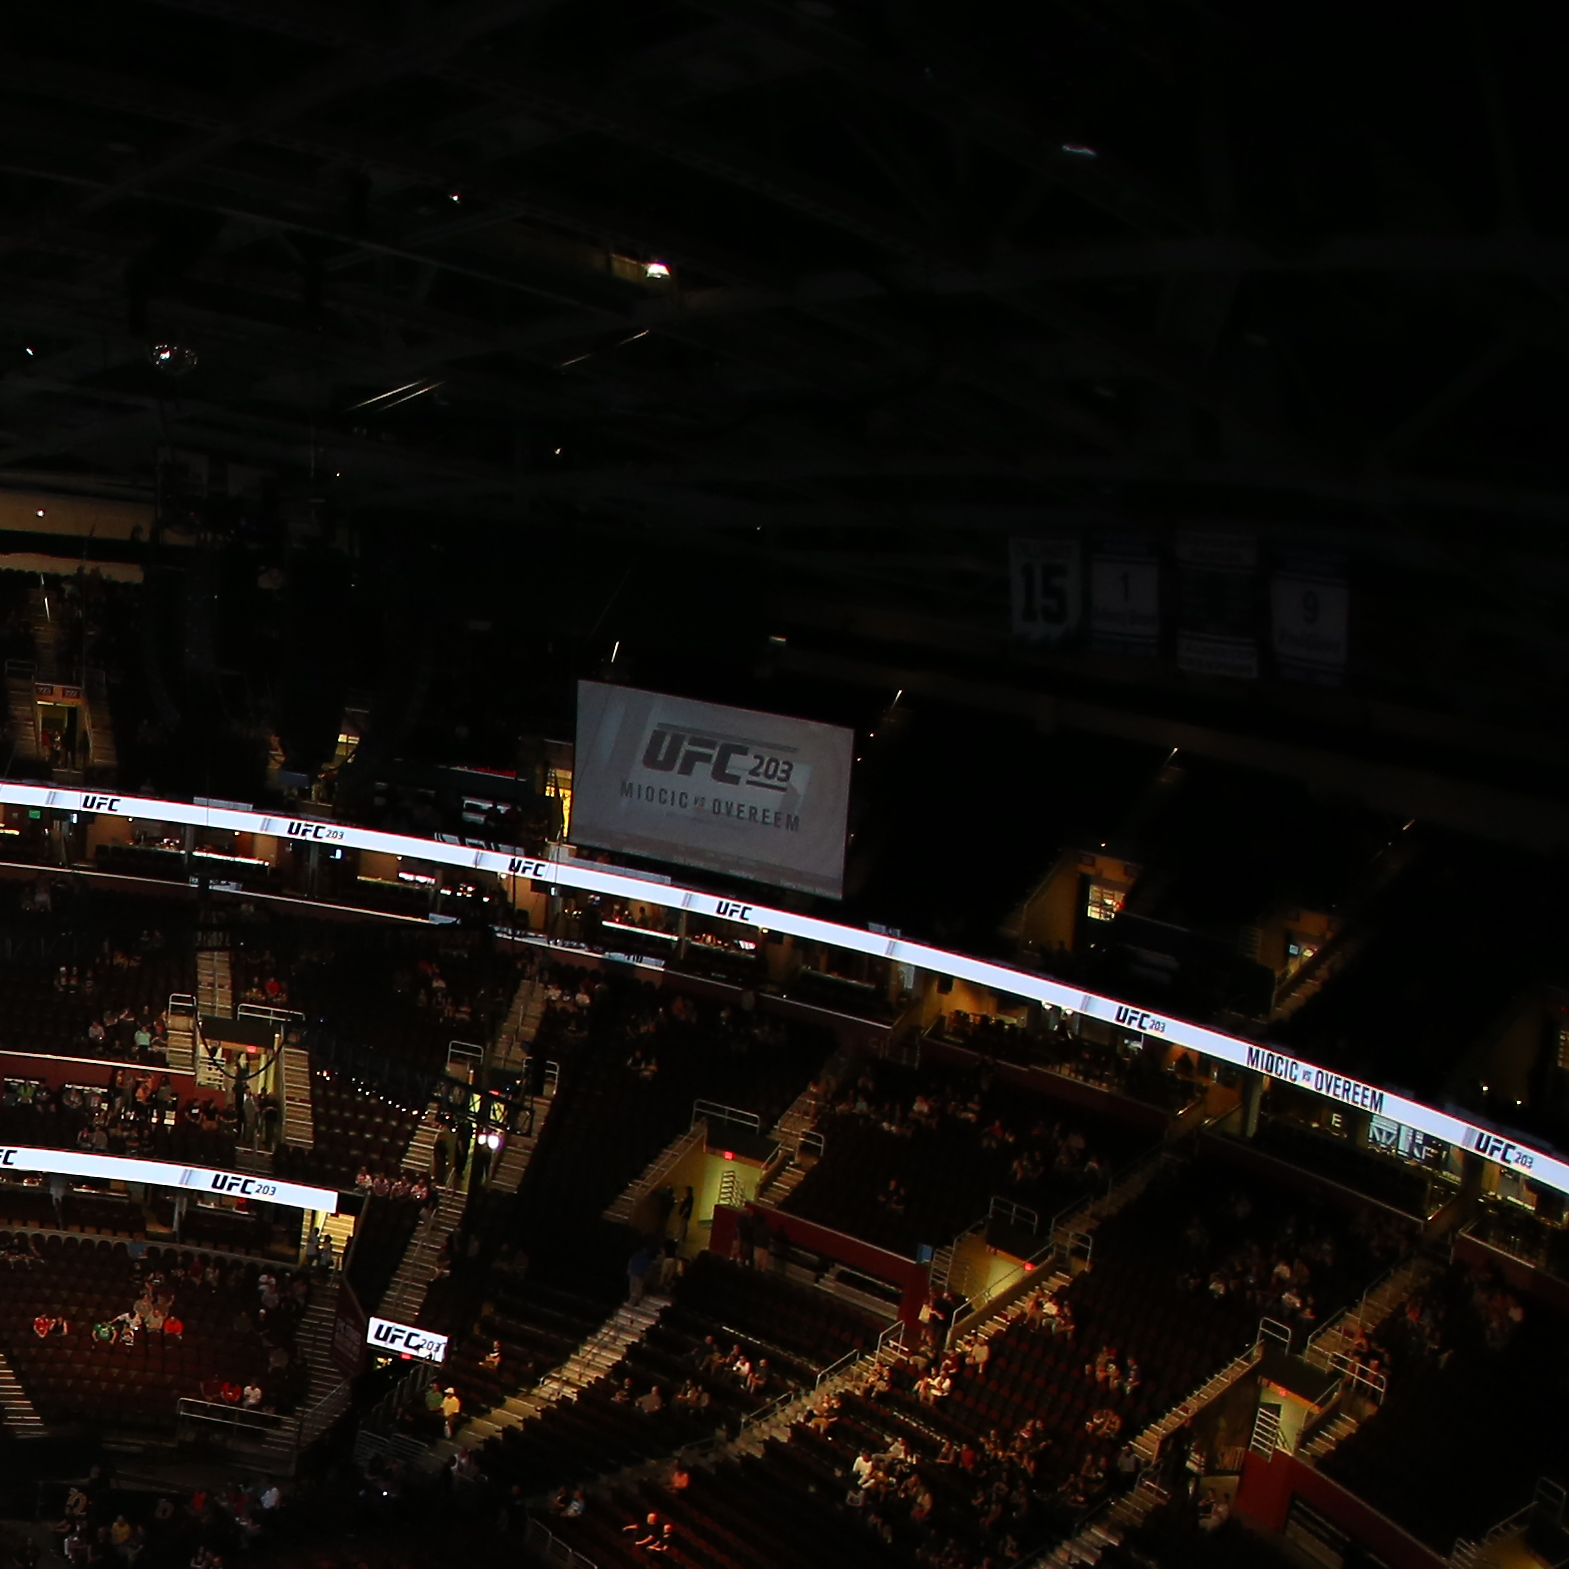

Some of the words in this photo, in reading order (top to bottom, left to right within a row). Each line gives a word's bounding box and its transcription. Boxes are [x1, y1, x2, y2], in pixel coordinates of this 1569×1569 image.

[1021, 563, 1068, 624] 15
[642, 729, 749, 785] UFC
[748, 755, 794, 782] 203
[83, 795, 121, 811] UFC
[620, 780, 689, 809] MIOCIC
[711, 798, 801, 832] OVEREEM
[287, 822, 326, 838] UFC
[326, 830, 344, 839] 203
[509, 858, 545, 877] UFC
[716, 901, 753, 920] UFC
[1115, 1006, 1150, 1030] UFC
[1149, 1020, 1166, 1032] 203
[1246, 1046, 1299, 1082] MIOCIC
[1314, 1070, 1383, 1112] OVEREEM
[1475, 1132, 1516, 1164] UFC
[1515, 1152, 1533, 1169] 203
[211, 1174, 255, 1195] UFC
[255, 1184, 276, 1196] 203
[374, 1324, 422, 1348] UFC
